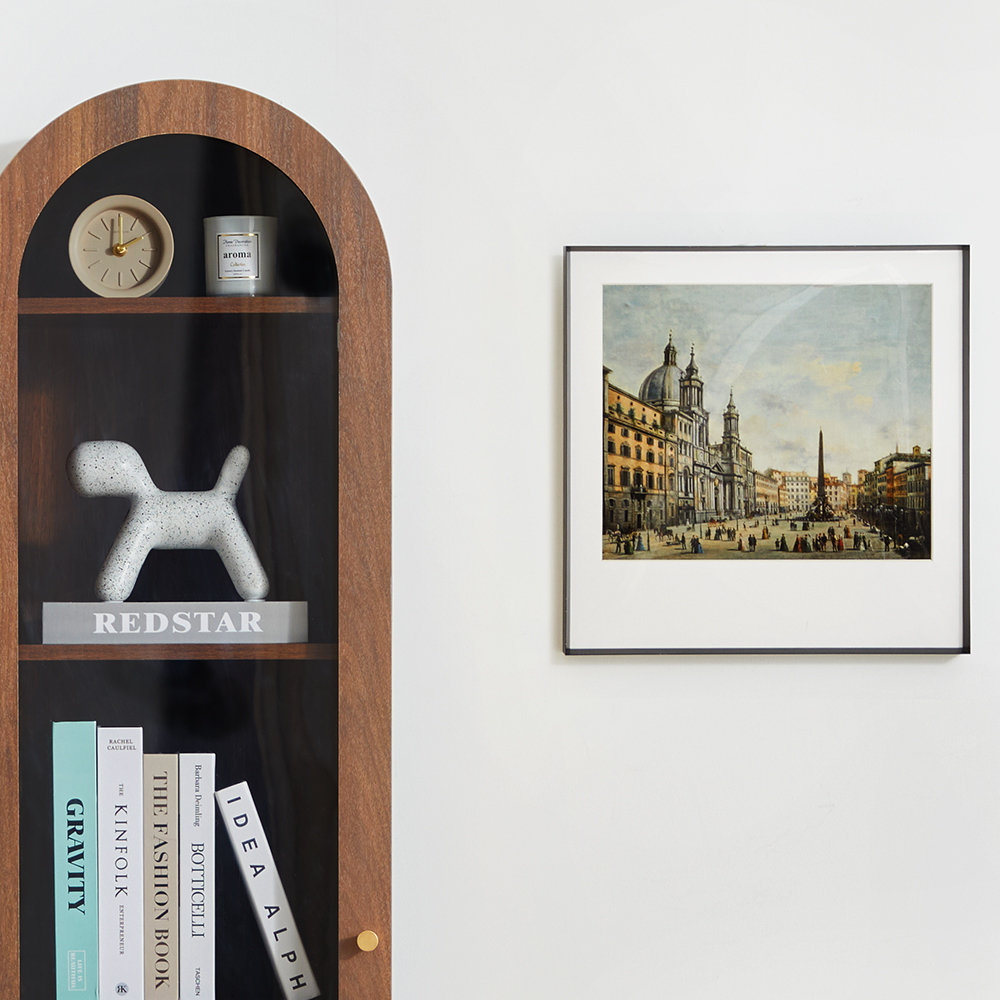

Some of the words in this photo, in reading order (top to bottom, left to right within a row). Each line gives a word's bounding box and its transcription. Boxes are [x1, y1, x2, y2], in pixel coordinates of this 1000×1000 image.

[223, 251, 252, 259] aroma
[93, 611, 264, 634] REDSTAR
[153, 770, 168, 816] THE
[194, 764, 202, 793] Barbara
[193, 794, 202, 827] Deimling
[66, 798, 86, 916] GRAVITY
[114, 804, 129, 898] KINFOLK
[153, 823, 169, 920] FASHION
[190, 842, 205, 938] BOTTICELLI
[227, 796, 266, 878] IDEA
[264, 905, 307, 990] ALPH
[154, 929, 170, 990] BOOK
